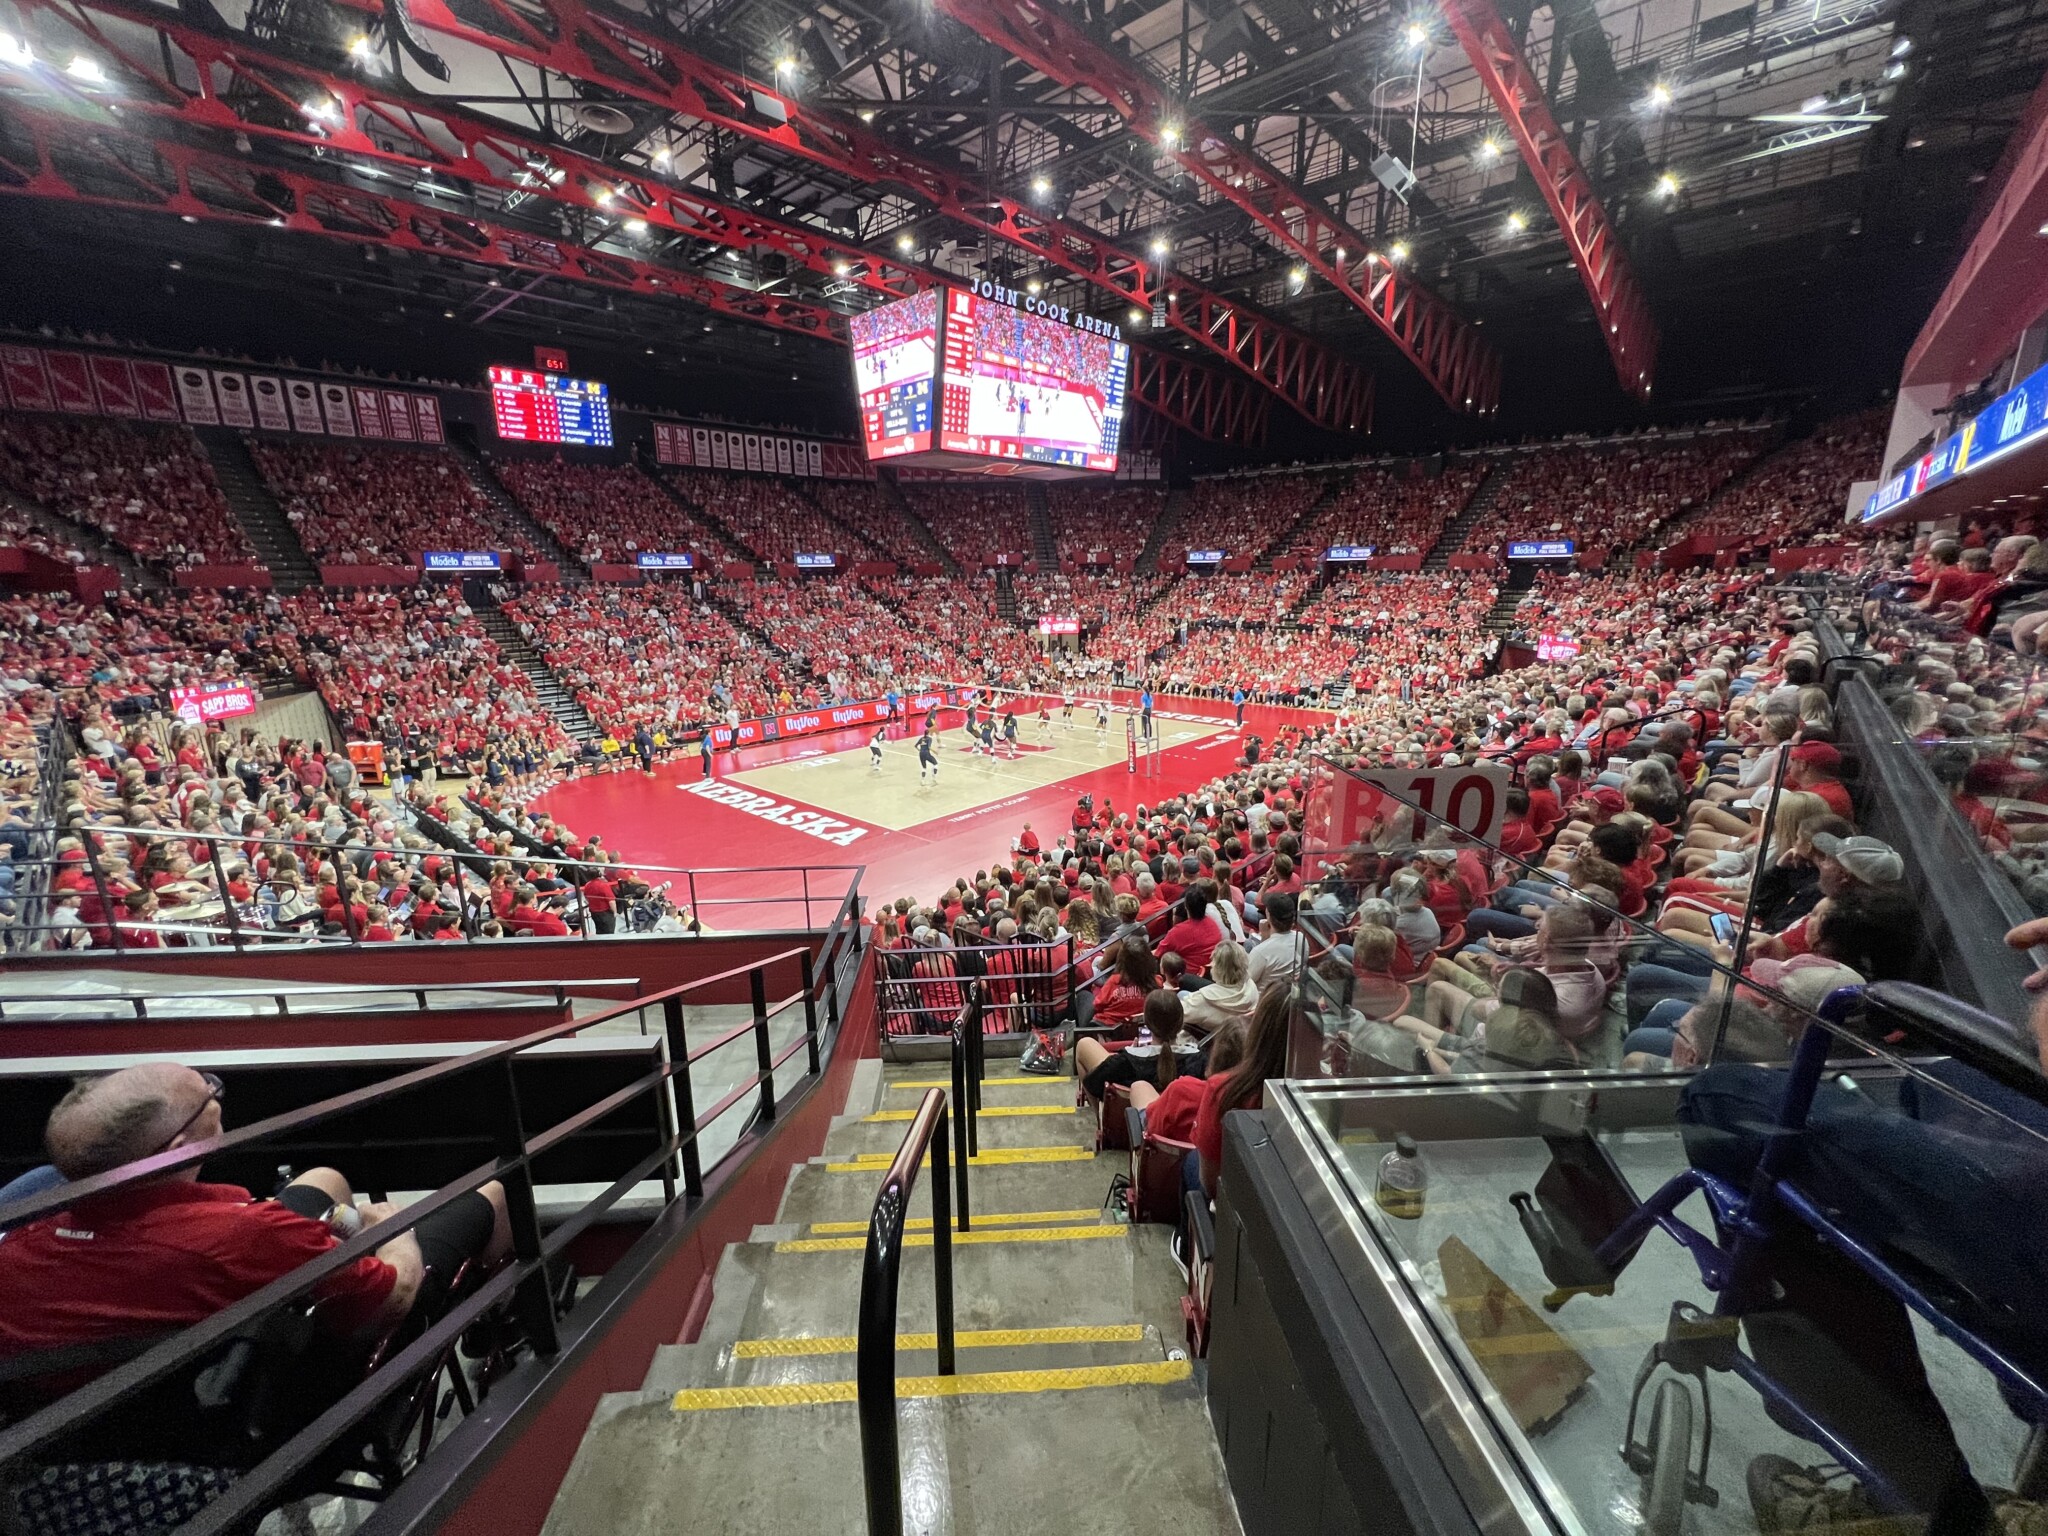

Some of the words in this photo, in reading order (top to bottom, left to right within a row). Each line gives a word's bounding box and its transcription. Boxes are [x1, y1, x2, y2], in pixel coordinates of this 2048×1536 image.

[970, 278, 1018, 307] JOHN
[1026, 297, 1069, 324] COOK
[1075, 313, 1120, 341] ARENA
[522, 374, 533, 384] 19
[587, 382, 600, 394] M
[356, 391, 376, 408] N
[387, 395, 407, 412] N
[416, 398, 436, 415] N
[657, 427, 670, 440] N
[675, 429, 688, 442] N
[1514, 545, 1536, 554] Modelo
[430, 556, 459, 566] Modelo
[642, 556, 662, 565] Modelo
[998, 554, 1007, 564] N
[1086, 553, 1097, 563] N
[201, 696, 224, 714] SAPP
[225, 694, 251, 707] BROS.
[876, 704, 905, 716] Hyee
[785, 716, 820, 731] HyVee
[832, 709, 864, 723] HyVee
[715, 727, 754, 742] Hyee
[765, 723, 776, 735] N
[676, 778, 869, 846] NEBRASKA
[948, 812, 976, 822] TERRY
[976, 804, 1003, 814] PETTIT
[1003, 796, 1030, 806] COURT
[1341, 778, 1385, 845] B
[1408, 774, 1494, 843] 10
